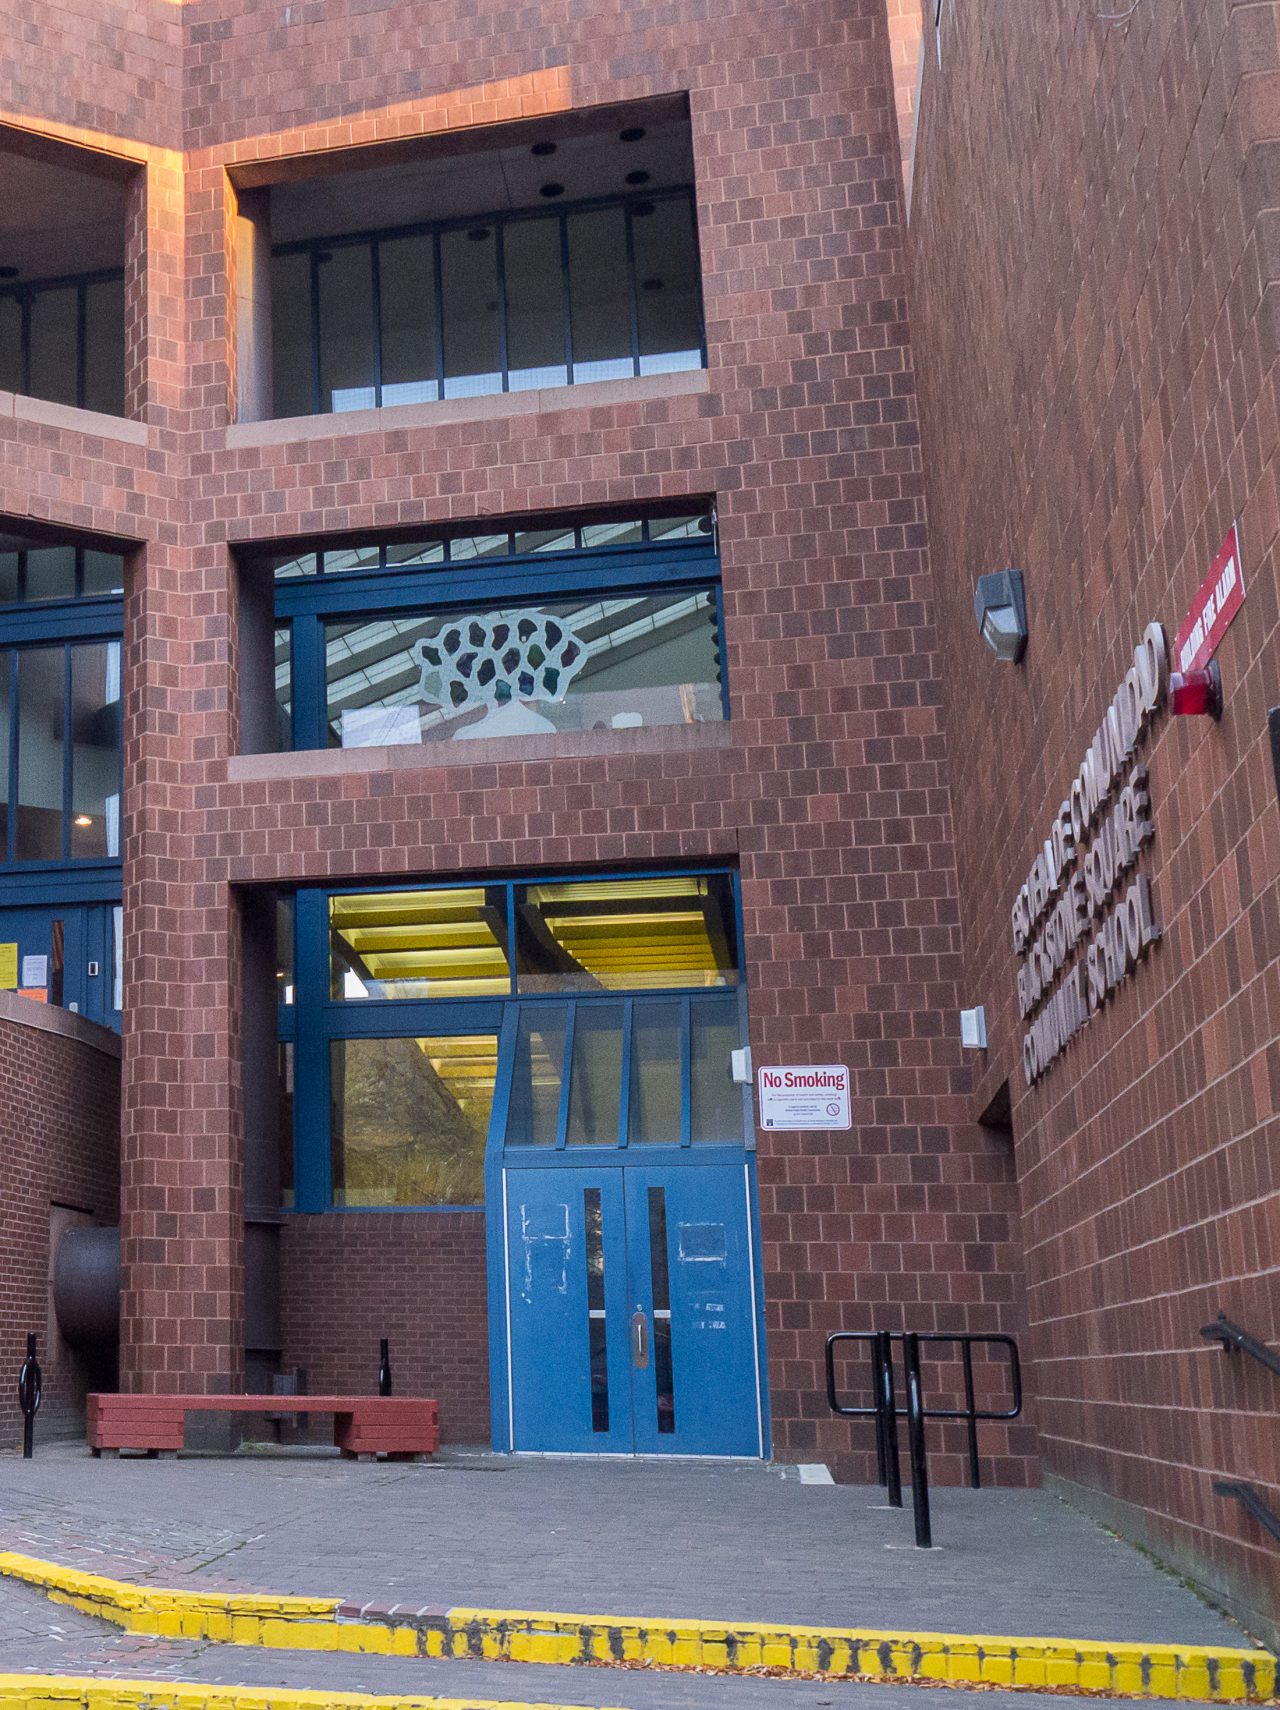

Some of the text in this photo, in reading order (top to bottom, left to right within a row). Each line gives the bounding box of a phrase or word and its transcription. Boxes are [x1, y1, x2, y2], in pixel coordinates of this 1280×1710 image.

[1052, 800, 1075, 880] DE
[1084, 764, 1153, 918] SQUARE
[1087, 874, 1160, 1009] SCHOOL
[764, 1071, 845, 1090] No Smoking
